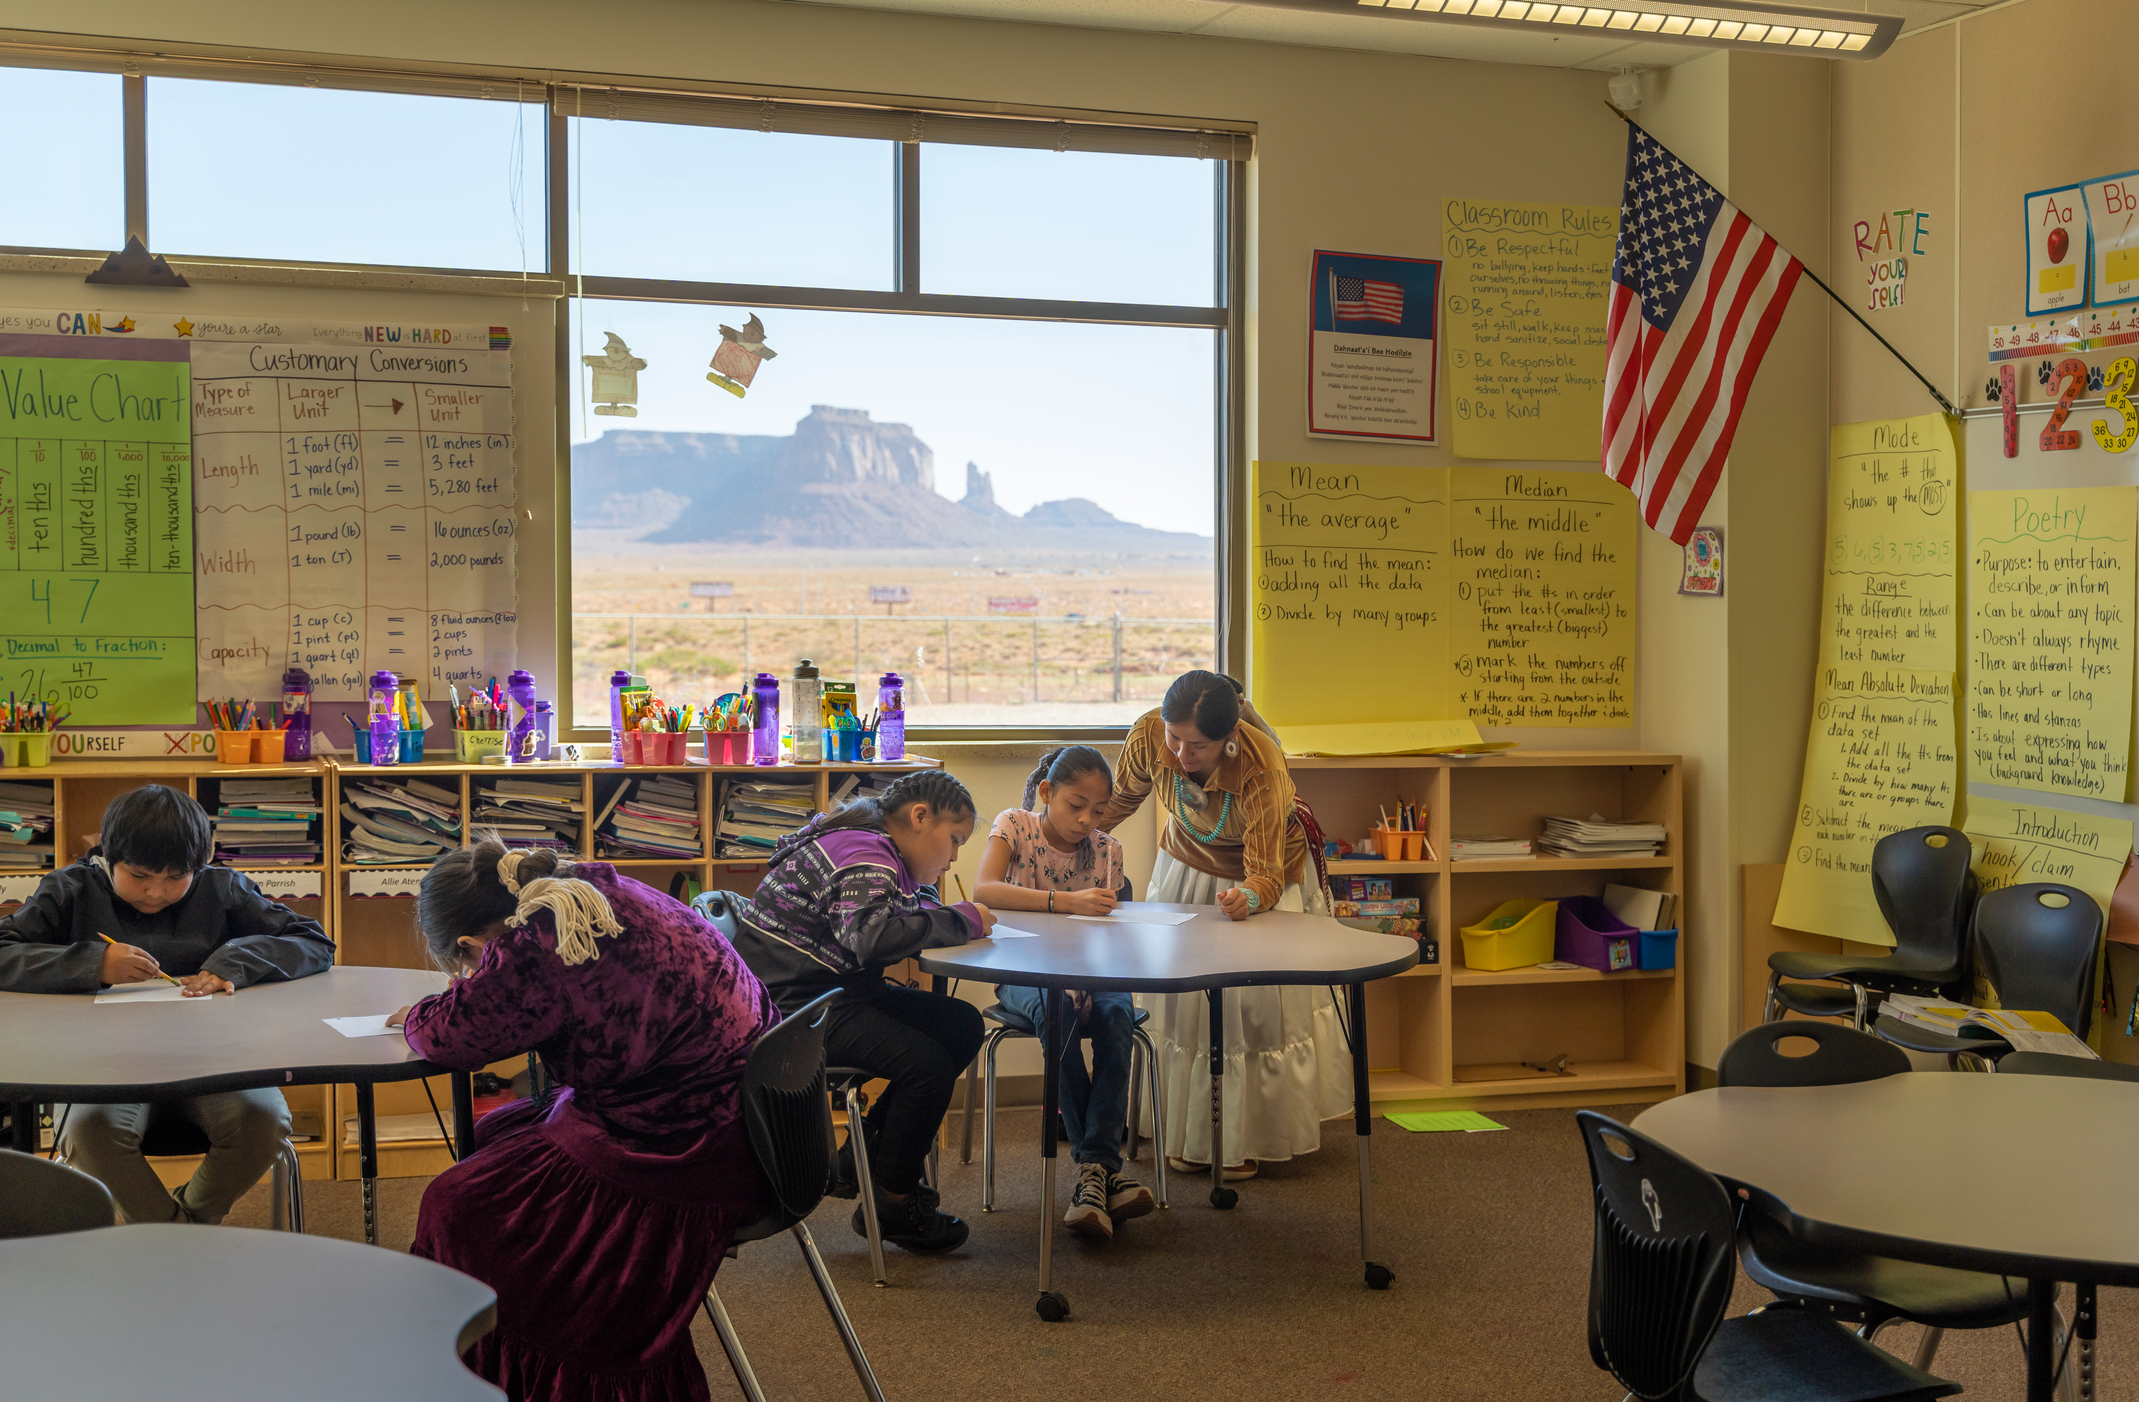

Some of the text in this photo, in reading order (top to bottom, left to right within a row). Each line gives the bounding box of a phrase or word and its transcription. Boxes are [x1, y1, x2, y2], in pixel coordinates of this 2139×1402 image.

[2104, 182, 2136, 214] Bb
[1447, 201, 1612, 231] Classroom Rules
[2043, 197, 2072, 227] Aa
[1854, 210, 1929, 262] RATE
[1466, 238, 1578, 259] Be Respectful
[1472, 262, 1484, 270] no
[1533, 262, 1553, 273] keep
[1557, 262, 1584, 272] hands
[2119, 282, 2130, 294] bat
[1472, 299, 1542, 318] Be Safe
[2048, 292, 2064, 307] apple
[57, 313, 100, 334] CAN
[253, 323, 283, 336] star
[313, 326, 486, 344] Everything NEW HARD first
[1476, 333, 1580, 345] hand social
[1993, 324, 2102, 348] -50 -48 -45
[250, 346, 468, 380] Customary Conversions
[1475, 352, 1576, 371] Be Responsible
[1474, 374, 1494, 383] take
[1537, 377, 1560, 386] your
[1565, 373, 1597, 390] things
[1476, 386, 1505, 395] school
[1, 368, 185, 422] Value Chart
[198, 382, 252, 405] Type of
[288, 383, 344, 404] Larger
[425, 388, 484, 406] Smaller
[195, 403, 255, 418] Measure
[293, 401, 329, 419] Unit
[431, 406, 461, 422] Unit
[1476, 400, 1540, 419] Be Kind
[1874, 422, 1919, 450] Mode
[2095, 426, 2105, 435] 36
[303, 433, 358, 454] foot (ft)
[426, 435, 481, 449] 12 inches
[2044, 436, 2076, 446] 20 24
[2117, 439, 2126, 448] 30
[80, 451, 96, 462] 100
[202, 454, 259, 488] Length
[305, 456, 358, 479] yard (yd)
[430, 478, 498, 496] 5,280 feet
[1291, 466, 1359, 490] Mean
[1506, 475, 1567, 497] Median
[434, 518, 513, 538] 16 ounces (oz)
[2014, 496, 2085, 543] Poetry
[305, 522, 361, 545] pound (lb)
[1265, 549, 1431, 570] How to find mean:
[1454, 537, 1616, 563] How do find the
[201, 548, 255, 575] Width
[431, 552, 503, 570] 2,000 pounds
[1983, 550, 2031, 576] Purpose:
[2037, 549, 2049, 571] to
[1271, 571, 1422, 602] adding data
[1867, 576, 1906, 600] Range
[1277, 604, 1437, 630] Divide by many groups
[1521, 601, 1610, 619] least (smallest)
[1861, 598, 1912, 619] difference
[2030, 601, 2122, 626] about topic
[444, 630, 467, 642] cups
[1506, 620, 1608, 639] greatest (biggest)
[7, 638, 60, 655] Decimal
[75, 638, 87, 652] to
[199, 637, 269, 666] Capacity
[1983, 628, 2120, 655] Doesn't always rhyme
[306, 650, 336, 669] quart
[445, 645, 473, 660] pints
[1841, 645, 1905, 663] least number
[433, 666, 482, 684] 4 quarts
[2030, 655, 2111, 679] different types
[1479, 670, 1621, 690] starting from outside
[1825, 668, 1949, 696] Mean Absolute Deviation
[2016, 681, 2092, 710] short long
[1558, 705, 1598, 723] together
[1831, 704, 1876, 723] Find the
[2045, 711, 2081, 728] stanzas
[1849, 741, 1867, 756] Add
[2024, 734, 2081, 760] expressing
[2052, 769, 2105, 795] knowledge)
[1816, 808, 1849, 827] Subtract
[2009, 809, 2099, 850] Introduction
